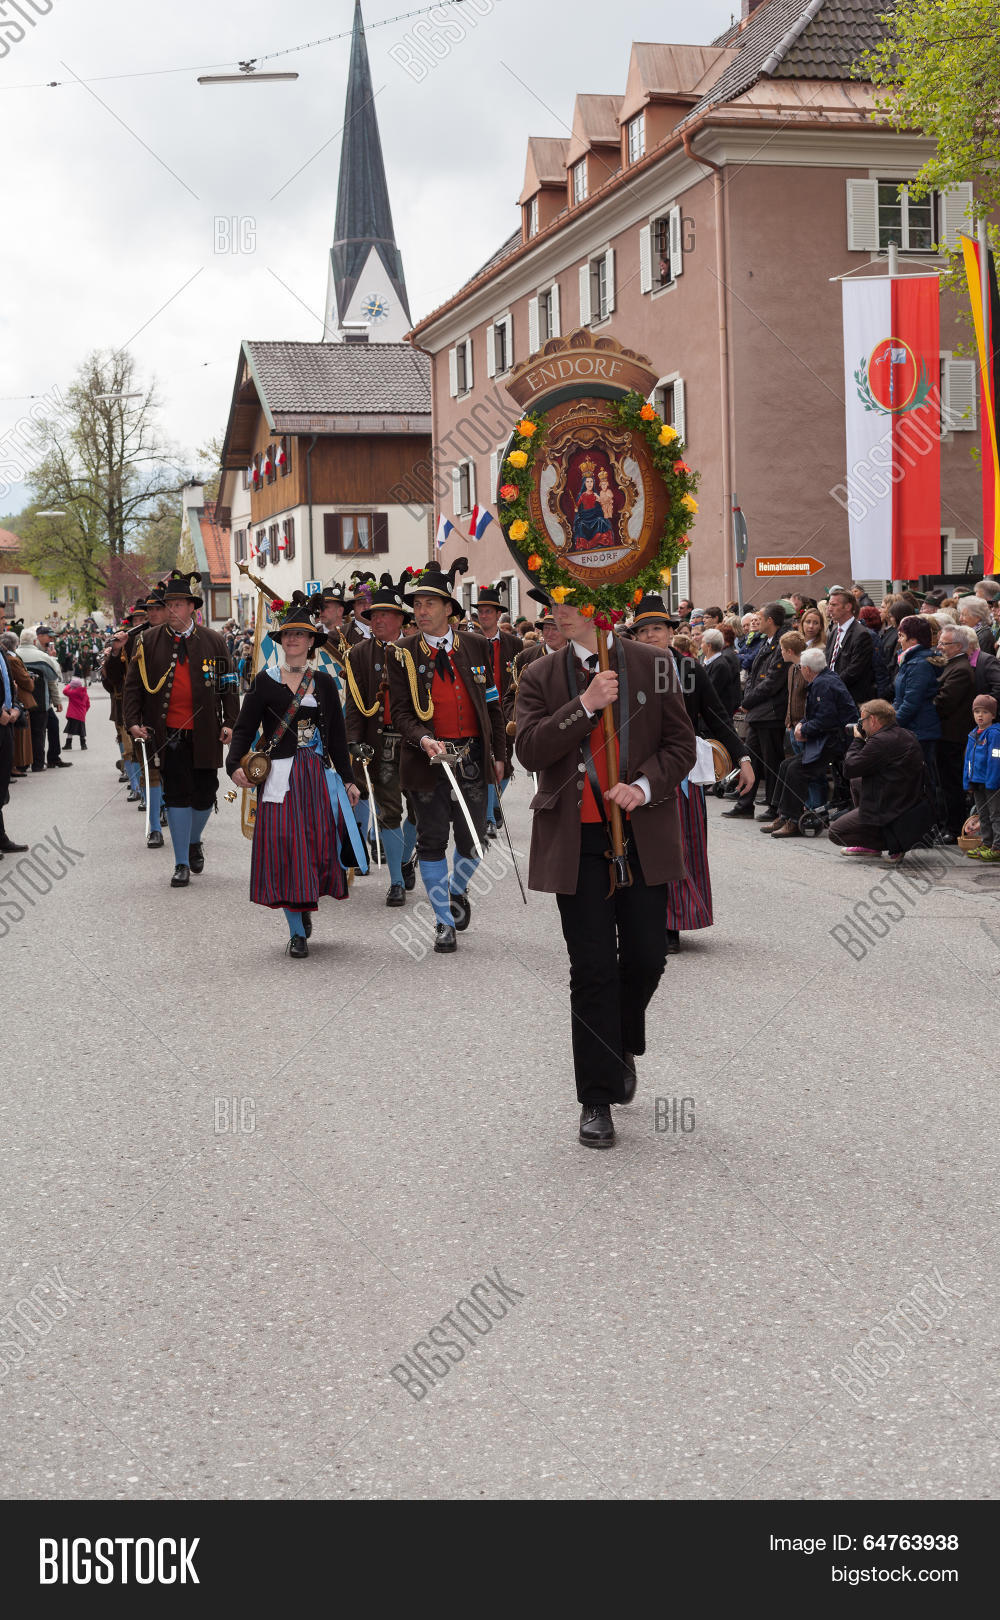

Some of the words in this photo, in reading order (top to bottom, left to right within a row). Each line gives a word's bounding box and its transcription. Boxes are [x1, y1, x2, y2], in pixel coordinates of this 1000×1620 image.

[525, 357, 623, 391] ENDORF
[581, 552, 618, 564] ENDORF
[758, 562, 810, 571] Heimatmuseum
